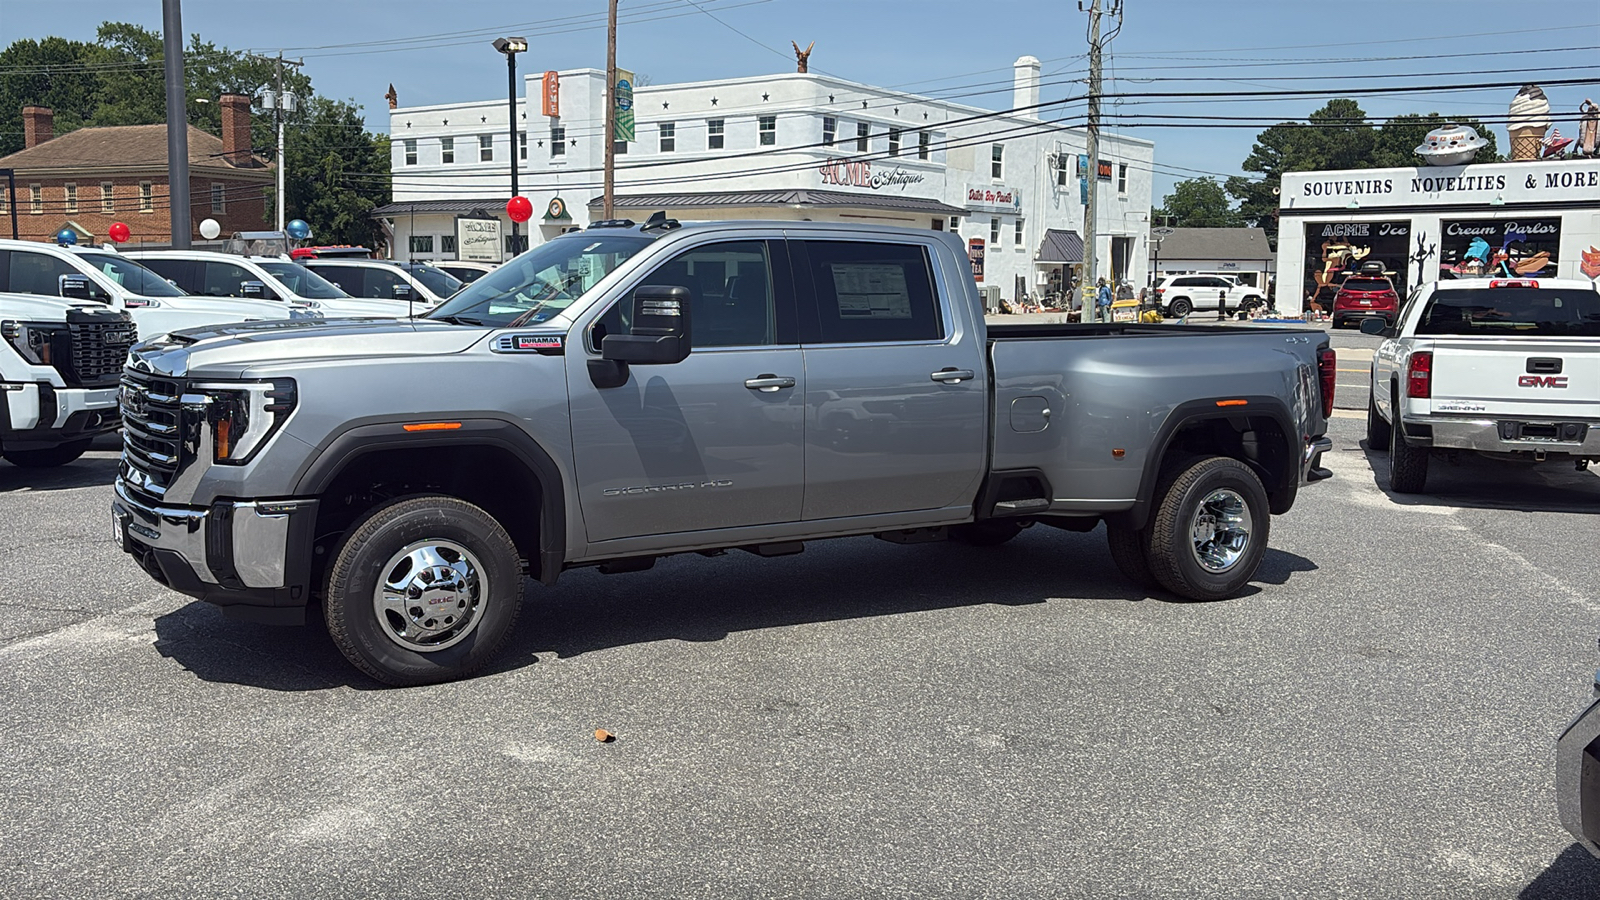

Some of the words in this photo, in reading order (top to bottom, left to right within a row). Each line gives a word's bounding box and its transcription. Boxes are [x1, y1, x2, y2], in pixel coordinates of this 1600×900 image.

[819, 157, 871, 188] ACME
[882, 164, 925, 191] Antiques
[1303, 179, 1393, 197] SOUVENIRS
[1411, 175, 1506, 193] NOVELTIES
[1525, 173, 1537, 189] &
[1545, 171, 1599, 188] MORE
[968, 189, 984, 201] Dutch
[985, 190, 996, 205] Boy
[996, 191, 1013, 204] Paints
[465, 221, 496, 233] ACME
[1321, 223, 1370, 237] ACME
[1379, 222, 1409, 236] Ice
[1446, 222, 1497, 236] Cream
[1503, 221, 1558, 235] Parlor
[579, 267, 590, 275] 25
[971, 263, 983, 274] TEA
[1518, 376, 1568, 388] GMC
[603, 483, 695, 496] SIERRA
[429, 596, 454, 606] GMC
